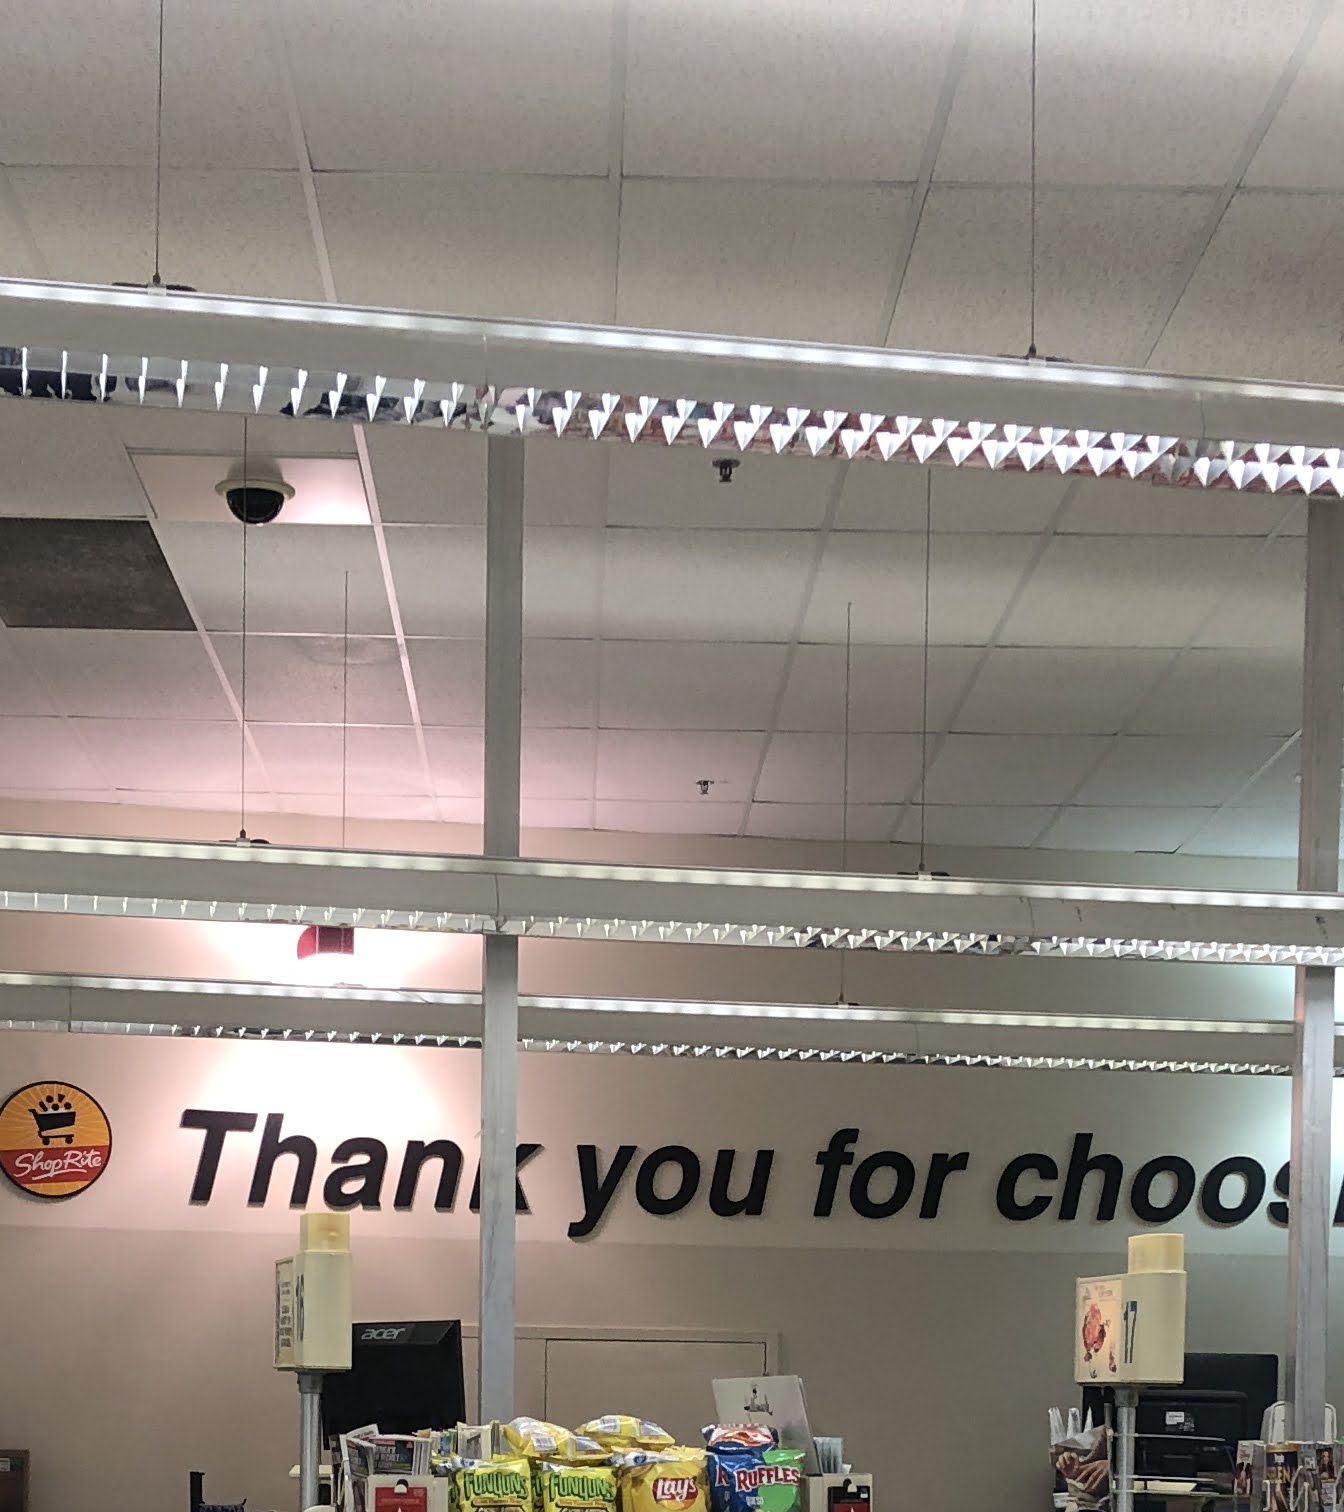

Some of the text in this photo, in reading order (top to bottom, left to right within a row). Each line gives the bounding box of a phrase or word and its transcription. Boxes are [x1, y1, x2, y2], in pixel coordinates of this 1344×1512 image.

[14, 1149, 102, 1178] ShopRite
[567, 1143, 775, 1240] you
[813, 1127, 971, 1219] for
[361, 1327, 406, 1340] acer
[1123, 1301, 1138, 1364] 17
[549, 1473, 616, 1502] FUNYUNS
[734, 1465, 802, 1493] RUFFLES
